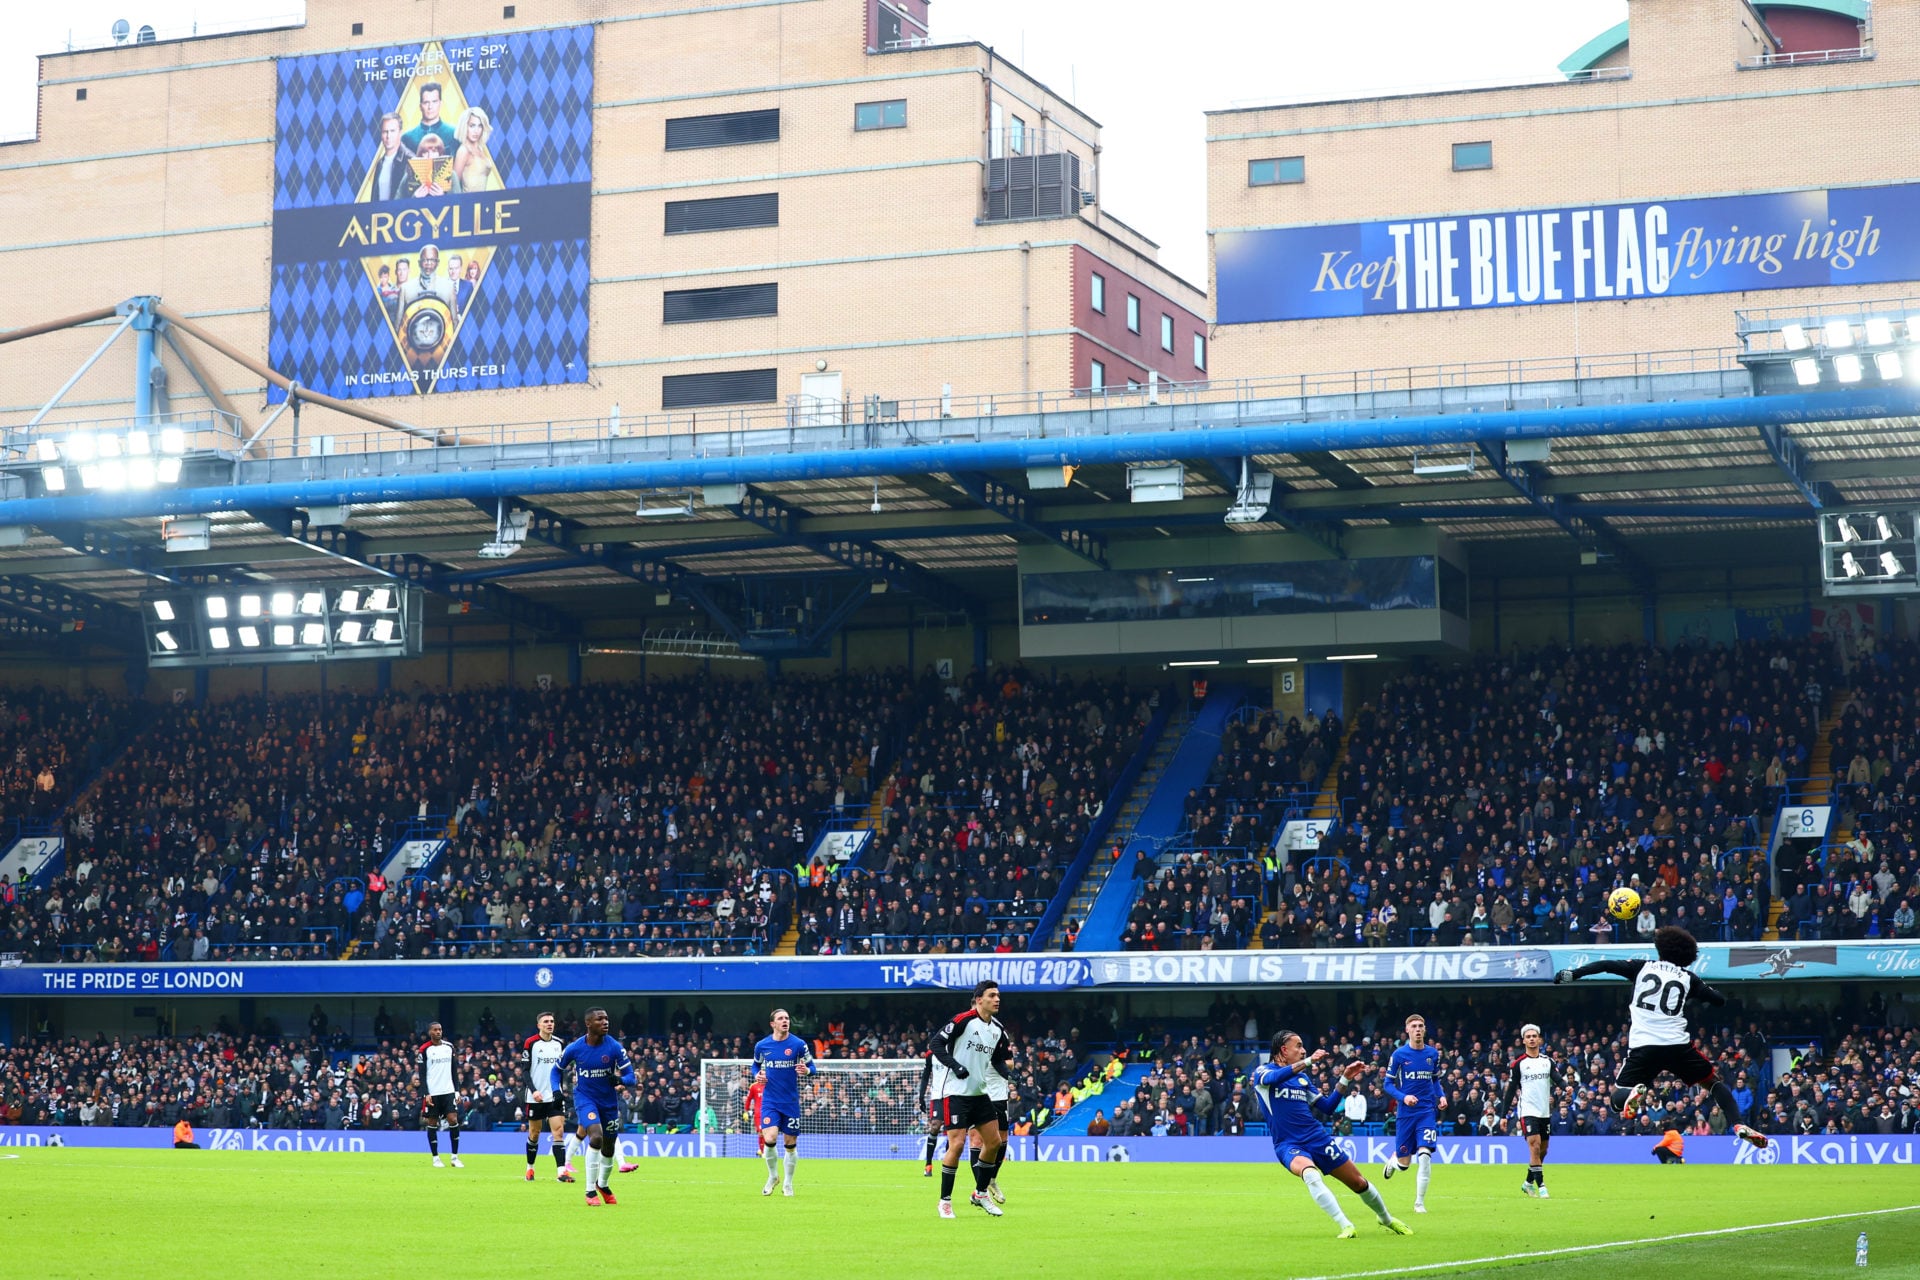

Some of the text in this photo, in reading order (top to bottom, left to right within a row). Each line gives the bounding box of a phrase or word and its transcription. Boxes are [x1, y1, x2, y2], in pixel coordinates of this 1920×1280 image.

[355, 43, 509, 69] THE GREATER THE SPY,
[363, 58, 501, 82] THE BIGGER THE LIE.
[338, 199, 520, 248] ARGYLLE
[1310, 205, 1881, 310] Keep THE BLUE FLAG flying high
[345, 364, 506, 386] IN CINEMAS THURS FEB 1
[940, 662, 950, 678] 4
[1284, 675, 1293, 692] 5
[1801, 809, 1815, 827] 6
[1306, 823, 1317, 839] 5
[38, 840, 48, 855] 2
[422, 843, 431, 858] 3
[844, 834, 856, 849] 4
[937, 959, 1037, 986] TAMBLING
[1129, 951, 1489, 982] BORN IS THE KING
[43, 971, 244, 989] THE PRIDE OF LONDON
[1636, 973, 1686, 1016] 20
[606, 1119, 620, 1131] 25
[787, 1117, 800, 1129] 23
[1423, 1128, 1437, 1141] 20
